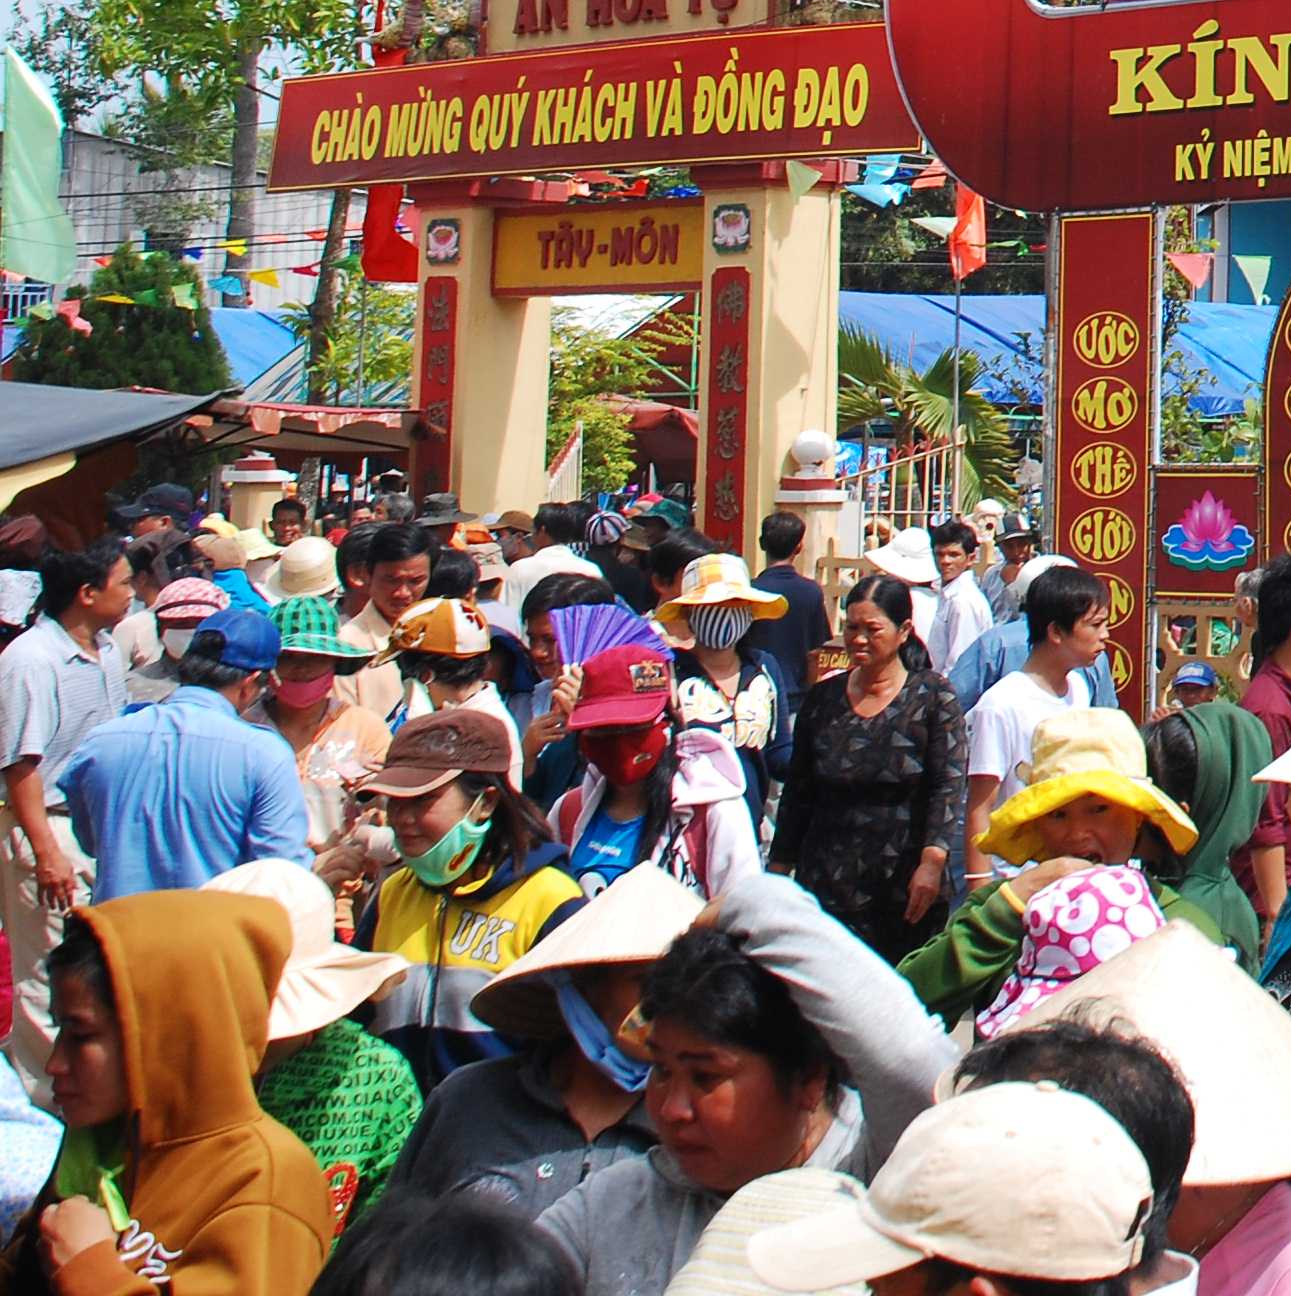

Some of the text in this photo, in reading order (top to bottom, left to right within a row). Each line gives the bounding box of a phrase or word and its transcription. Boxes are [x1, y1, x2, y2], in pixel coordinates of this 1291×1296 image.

[312, 48, 868, 164] CHÀO MỪNG QUÝ KHÁCH VÀ ĐỒNG ĐẠO
[1176, 143, 1214, 181] KỶ
[1075, 315, 1135, 560] ƯỚC MƠ THẾ GIỚI
[450, 910, 516, 964] UK
